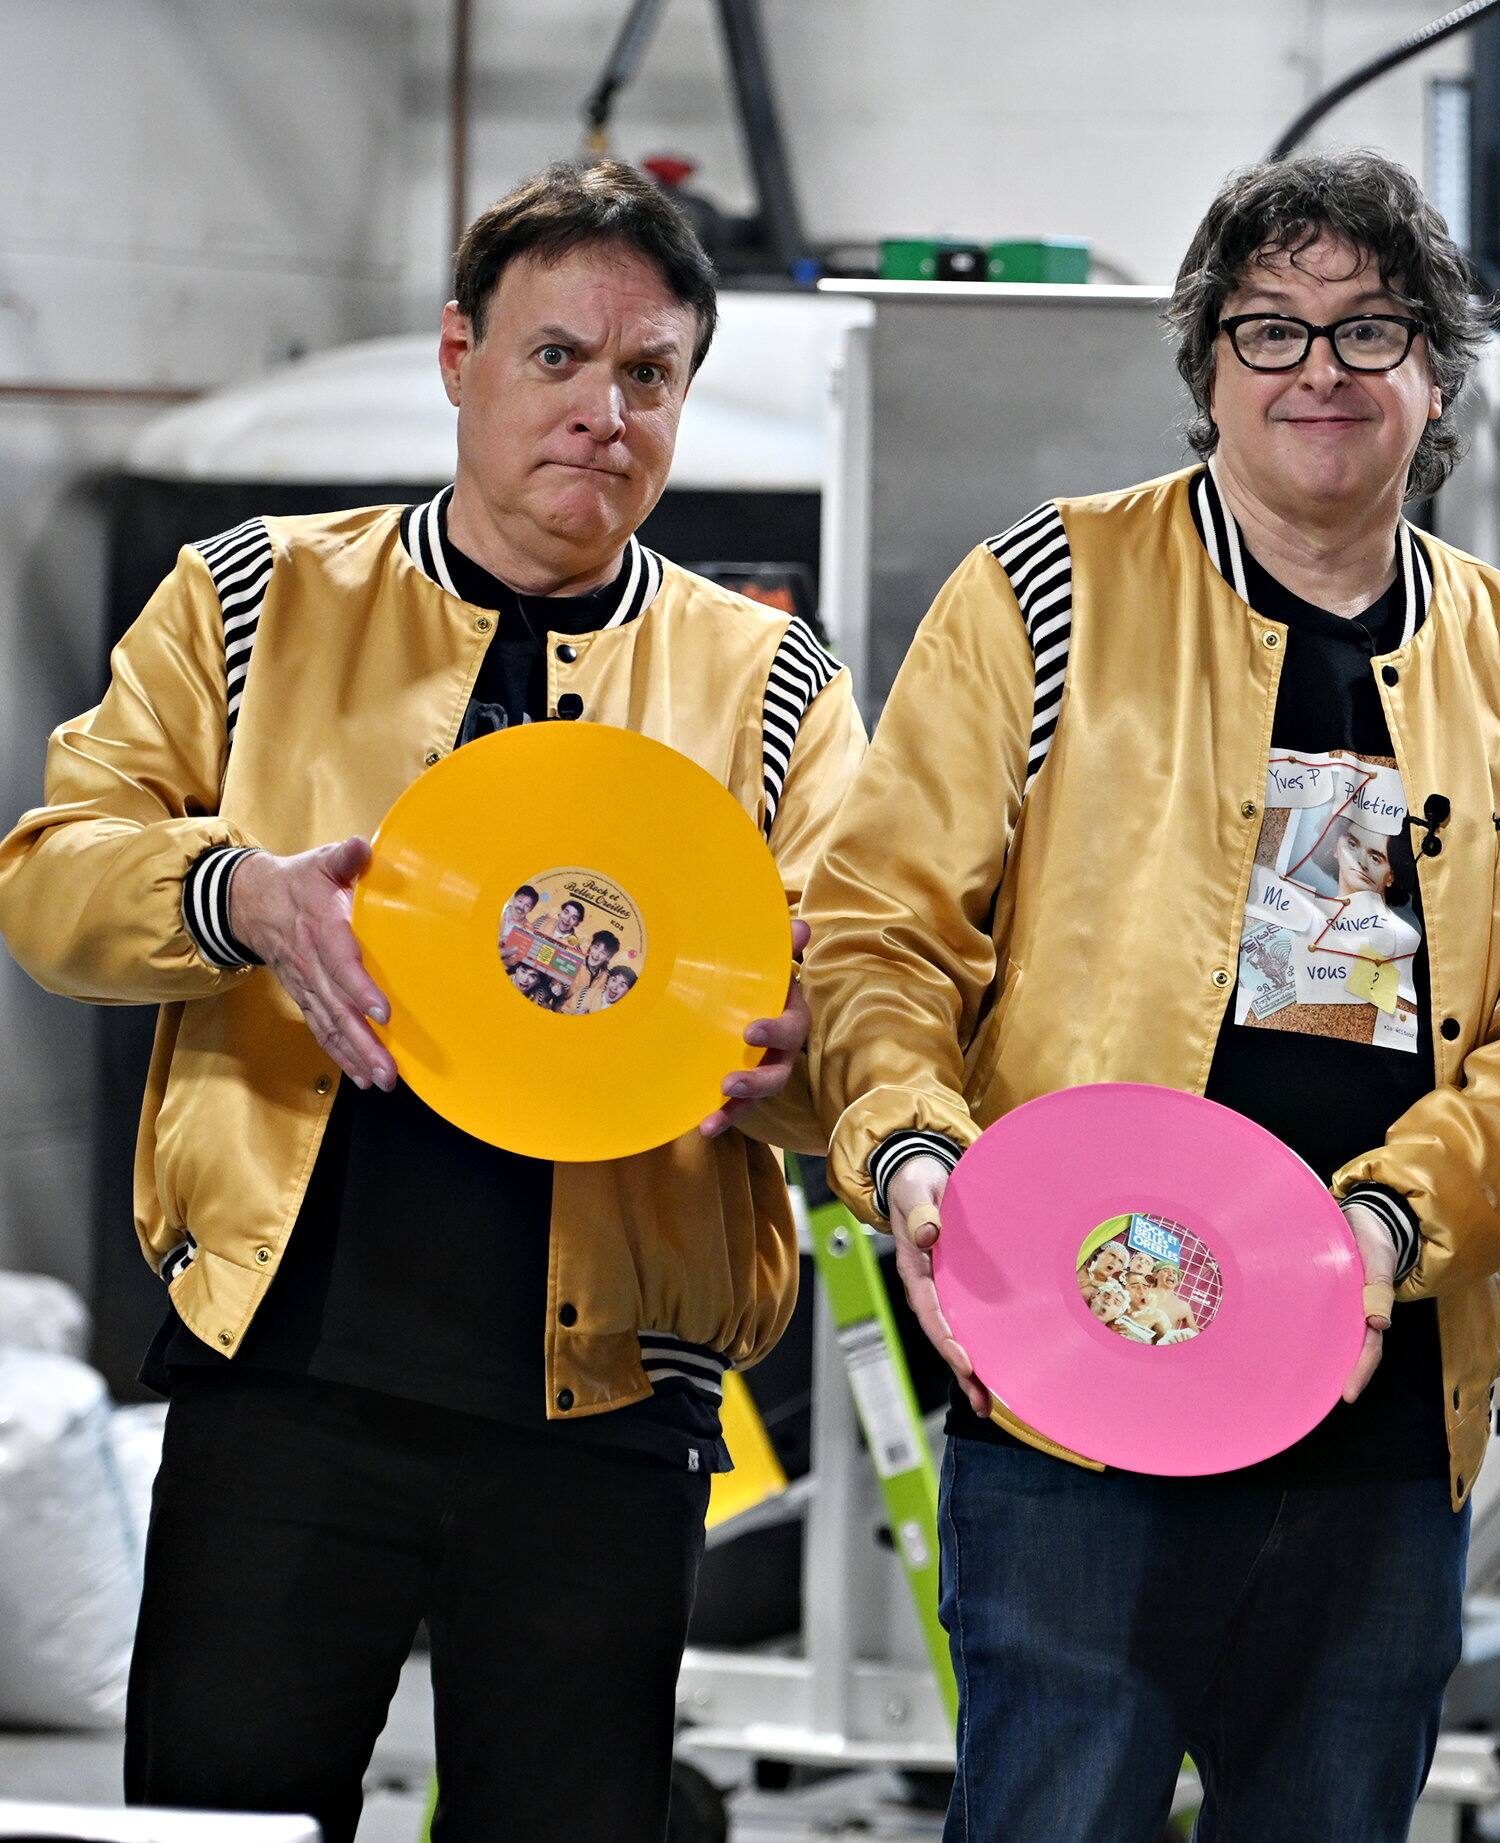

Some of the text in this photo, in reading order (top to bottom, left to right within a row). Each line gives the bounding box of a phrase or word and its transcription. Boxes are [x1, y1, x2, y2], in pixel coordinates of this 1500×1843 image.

[1267, 768, 1321, 793] Yves P
[1344, 781, 1405, 818] Pelletier
[563, 881, 631, 918] Belles Oreilles
[582, 880, 609, 897] Rock
[1262, 885, 1291, 911] Me
[1306, 965, 1347, 980] vous
[1134, 1225, 1169, 1250] BELLES
[1135, 1216, 1180, 1246] ROCK ET
[1133, 1235, 1179, 1263] OREILLES
